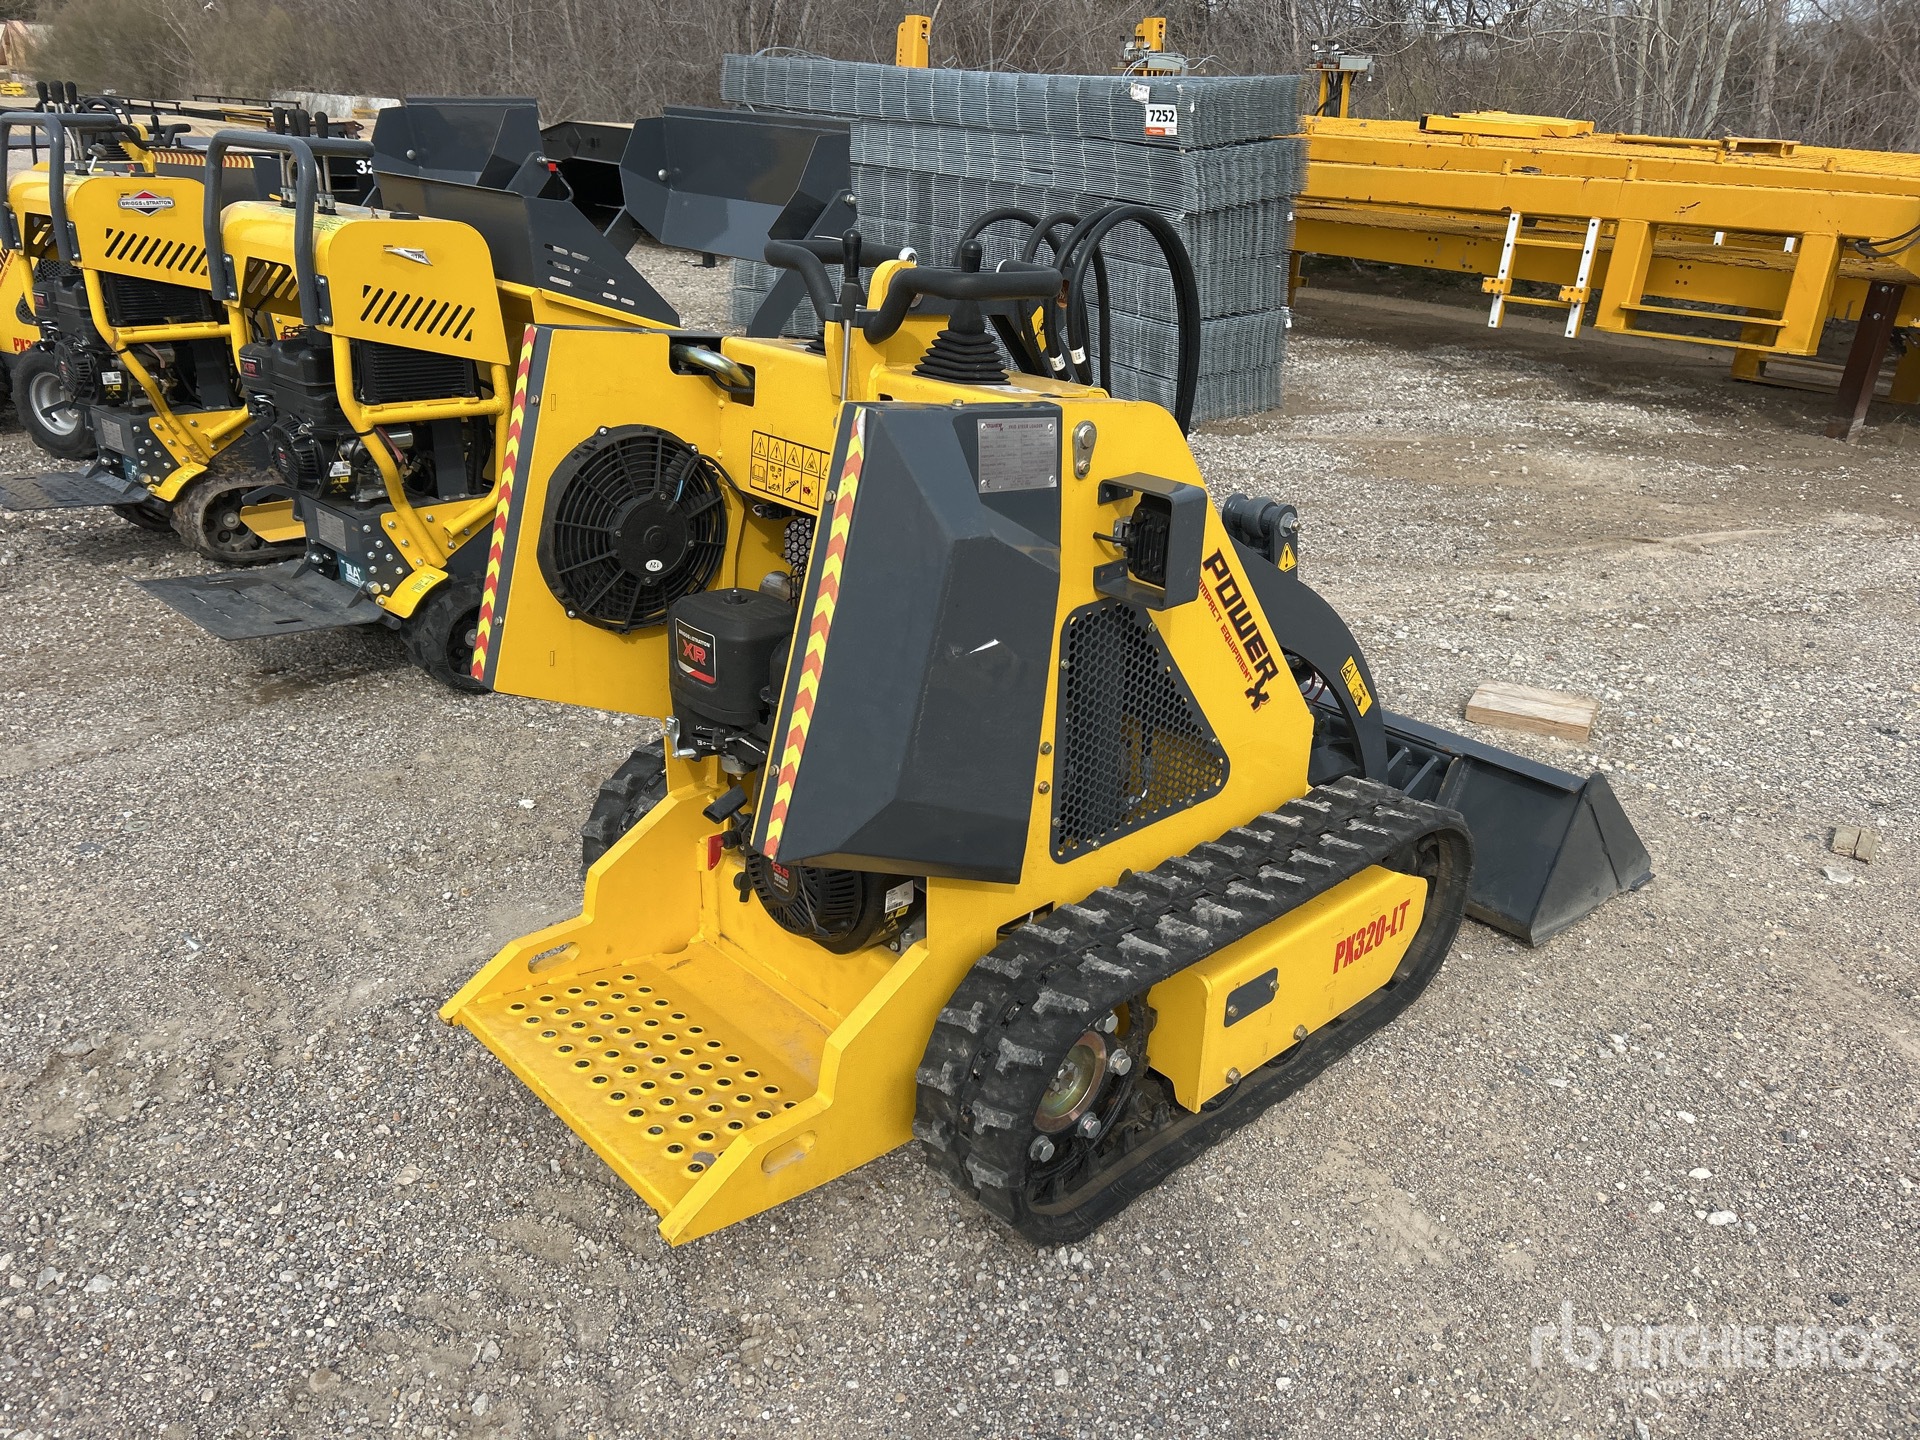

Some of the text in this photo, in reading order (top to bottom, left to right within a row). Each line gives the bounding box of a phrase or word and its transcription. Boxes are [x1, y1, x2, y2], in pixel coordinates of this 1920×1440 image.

[1150, 110, 1175, 122] 7252
[683, 639, 706, 666] XR
[1199, 576, 1253, 682] OMPACT EQUIPMENT
[1202, 548, 1279, 681] POWER
[1333, 898, 1411, 975] PX320-LT
